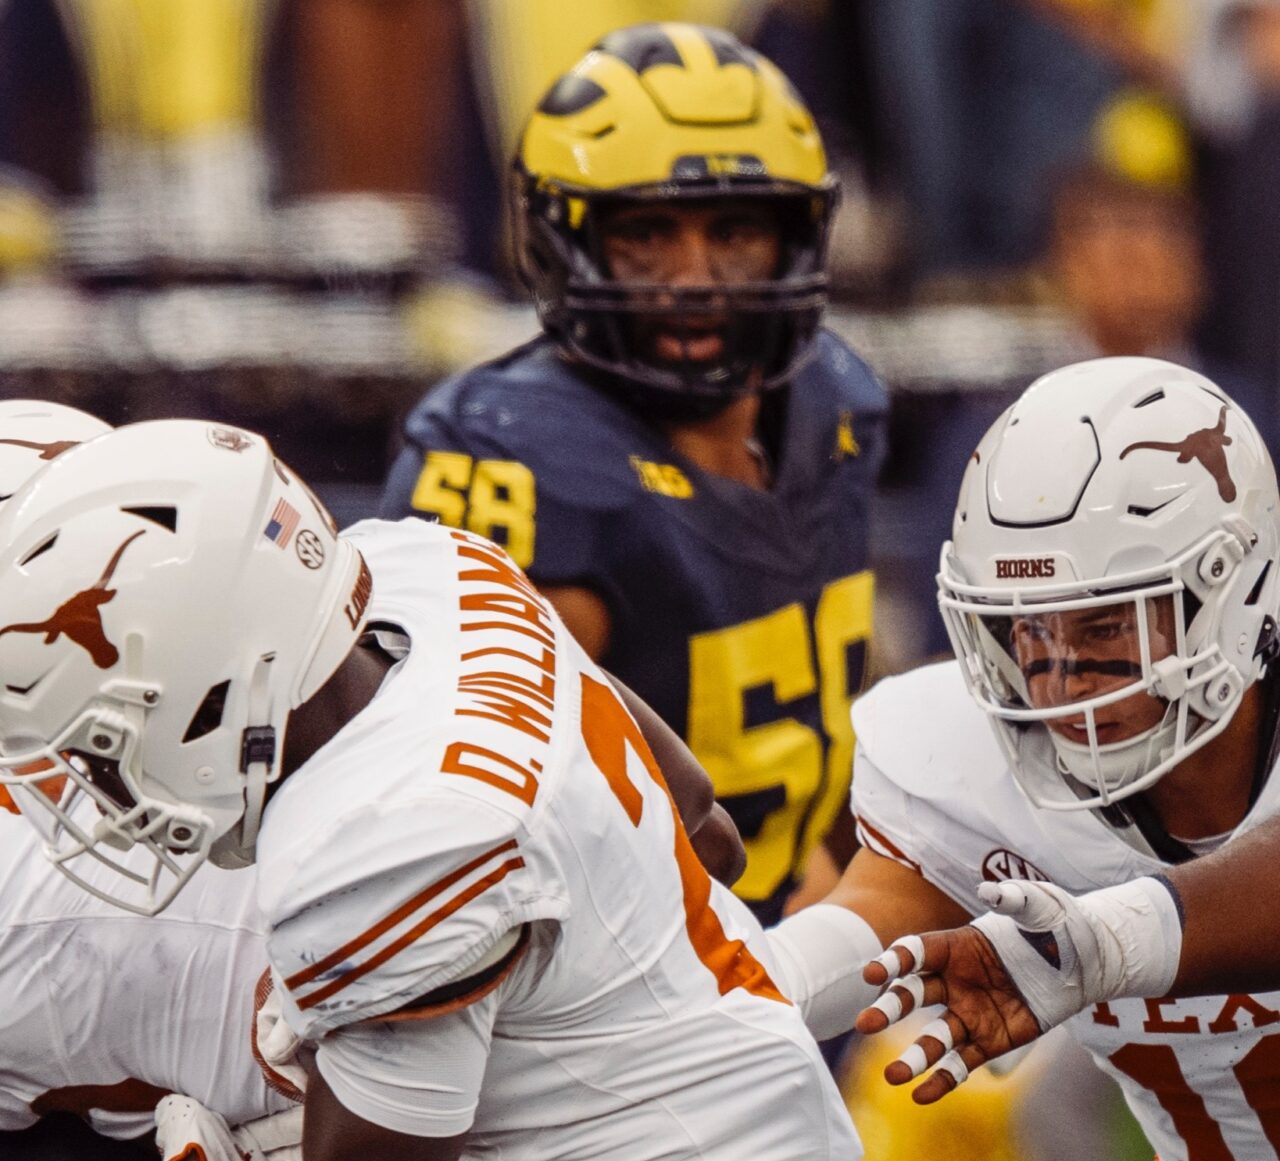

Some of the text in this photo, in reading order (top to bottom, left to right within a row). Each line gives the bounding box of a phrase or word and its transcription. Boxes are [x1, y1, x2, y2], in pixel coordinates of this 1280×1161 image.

[411, 451, 536, 569] 58
[995, 558, 1056, 579] HORNS
[440, 741, 543, 808] D.
